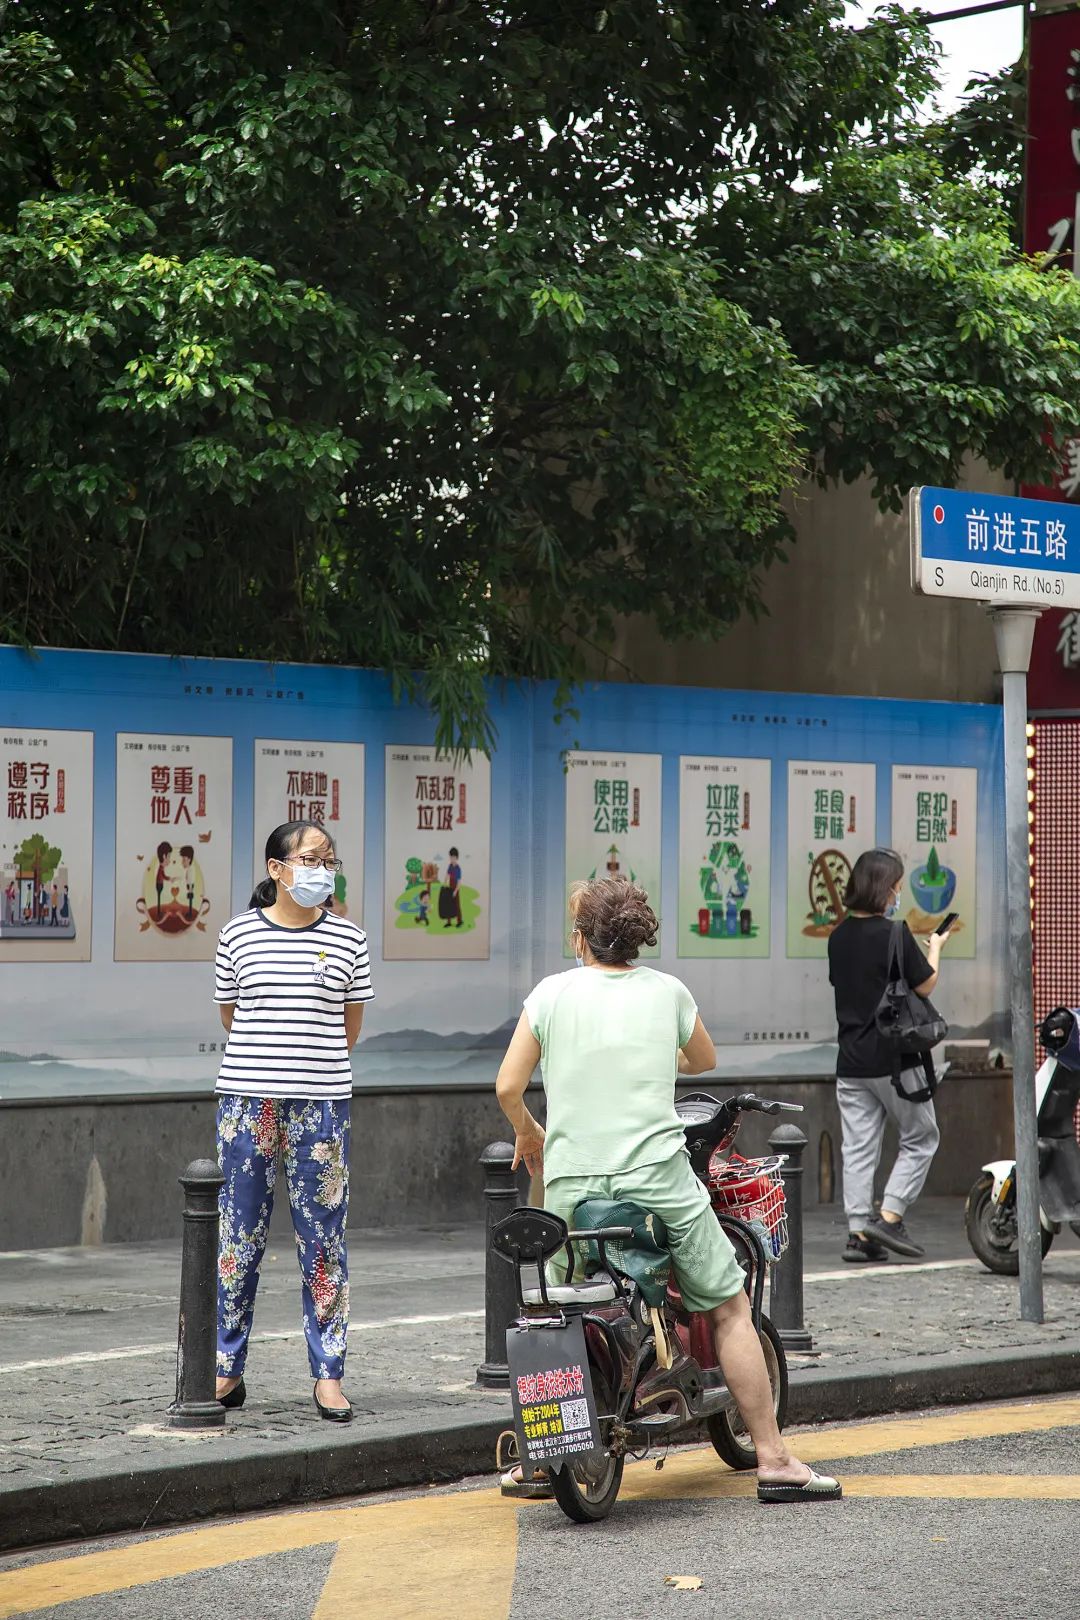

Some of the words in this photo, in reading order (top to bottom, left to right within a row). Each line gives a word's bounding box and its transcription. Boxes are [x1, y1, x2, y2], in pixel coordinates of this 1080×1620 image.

[966, 508, 1068, 561] 前进五路
[934, 566, 945, 587] S
[970, 570, 1008, 593] Qianjin
[8, 761, 50, 790] 遵守
[151, 765, 193, 794] 尊重
[286, 770, 328, 797] 不随地
[416, 775, 455, 801] 不乱扔
[7, 792, 49, 820] 秩序
[594, 779, 629, 806] 使用
[706, 784, 739, 810] 垃圾
[814, 789, 844, 814] 拒食
[916, 792, 948, 817] 保护
[151, 796, 193, 825] 他人
[288, 800, 325, 826] 吐痰
[417, 804, 453, 831] 垃圾
[594, 807, 629, 834] 公筷
[706, 810, 739, 837] 分类
[814, 815, 844, 840] 野味
[916, 818, 948, 843] 自然
